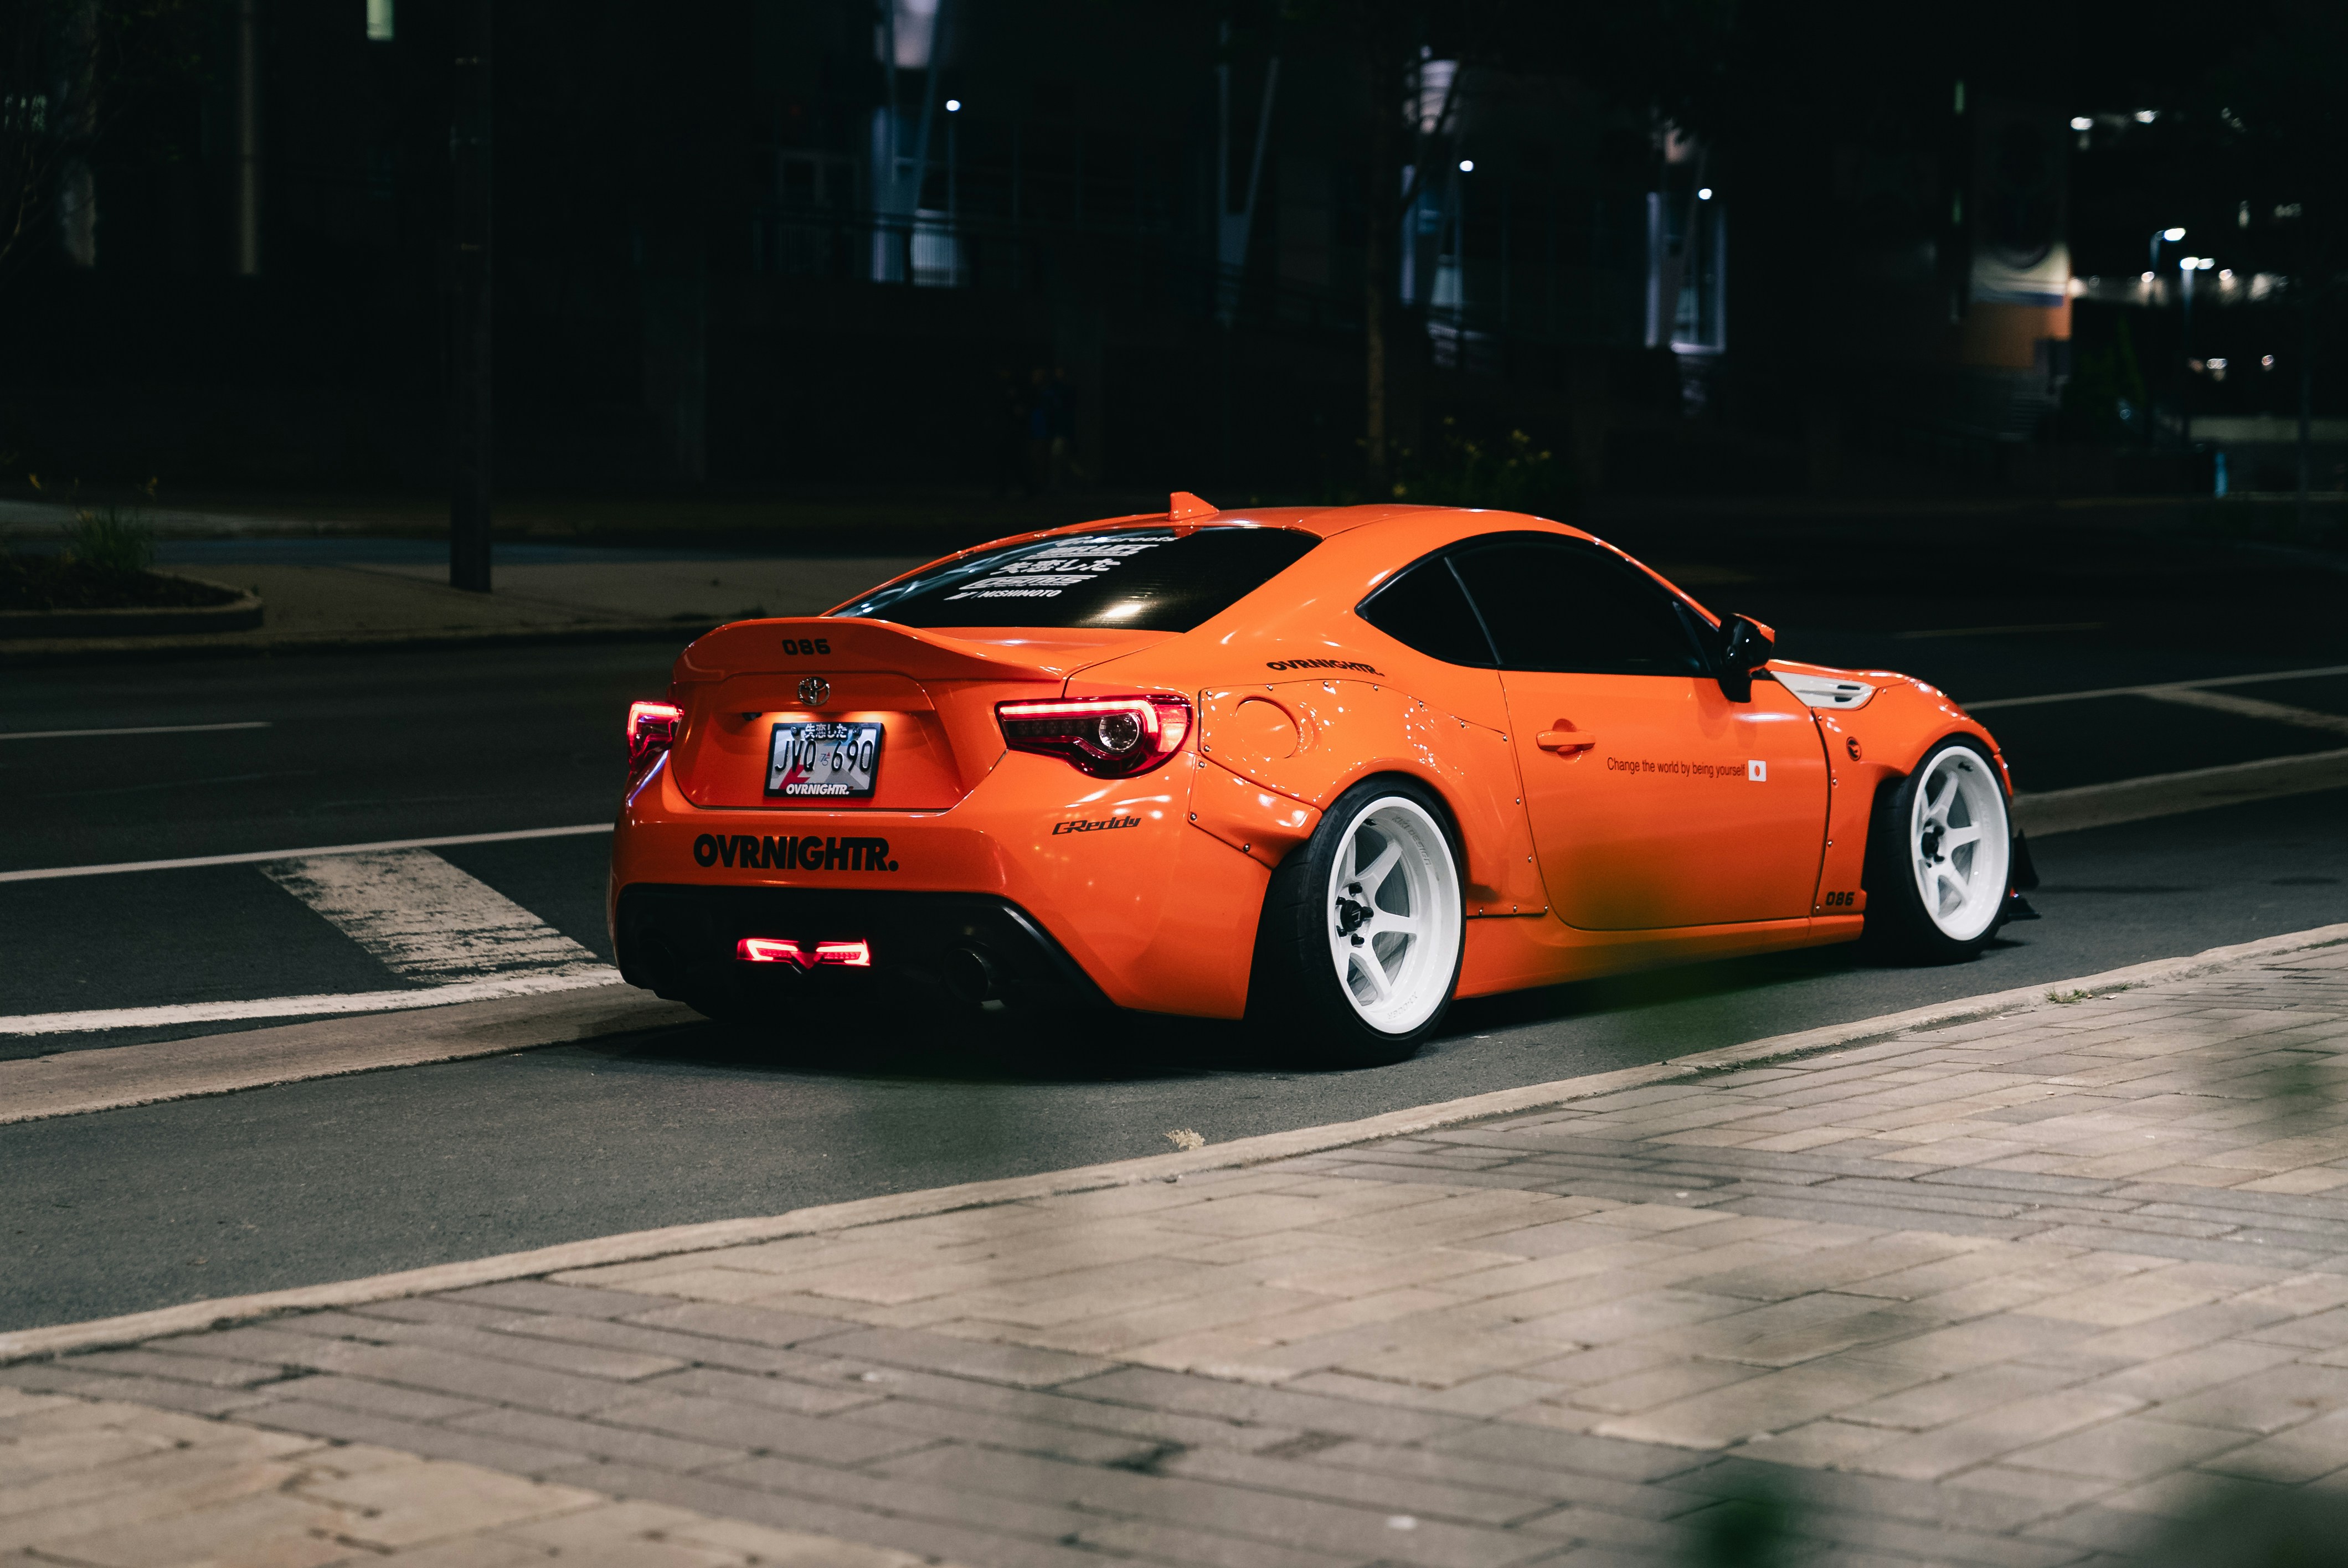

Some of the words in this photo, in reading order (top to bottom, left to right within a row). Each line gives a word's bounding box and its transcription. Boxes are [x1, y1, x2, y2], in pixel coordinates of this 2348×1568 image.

[990, 558, 1121, 575] 失恋した
[977, 590, 1062, 598] MISHIMOTO
[782, 638, 831, 655] 086
[1266, 659, 1385, 677] OVRNIGHTR.
[805, 723, 847, 739] 失恋した
[775, 739, 817, 772] JVQ
[831, 740, 873, 772] 690
[1607, 757, 1640, 774] Change
[1642, 759, 1655, 772] the
[1657, 761, 1678, 773] world
[1681, 761, 1690, 777] by
[1692, 762, 1713, 778] being
[1716, 764, 1745, 778] yourself
[786, 783, 849, 795] OVRNIGHTR.
[1052, 816, 1141, 835] GReddy
[693, 833, 899, 872] OVRNIGHTR.
[1826, 891, 1855, 906] 086
